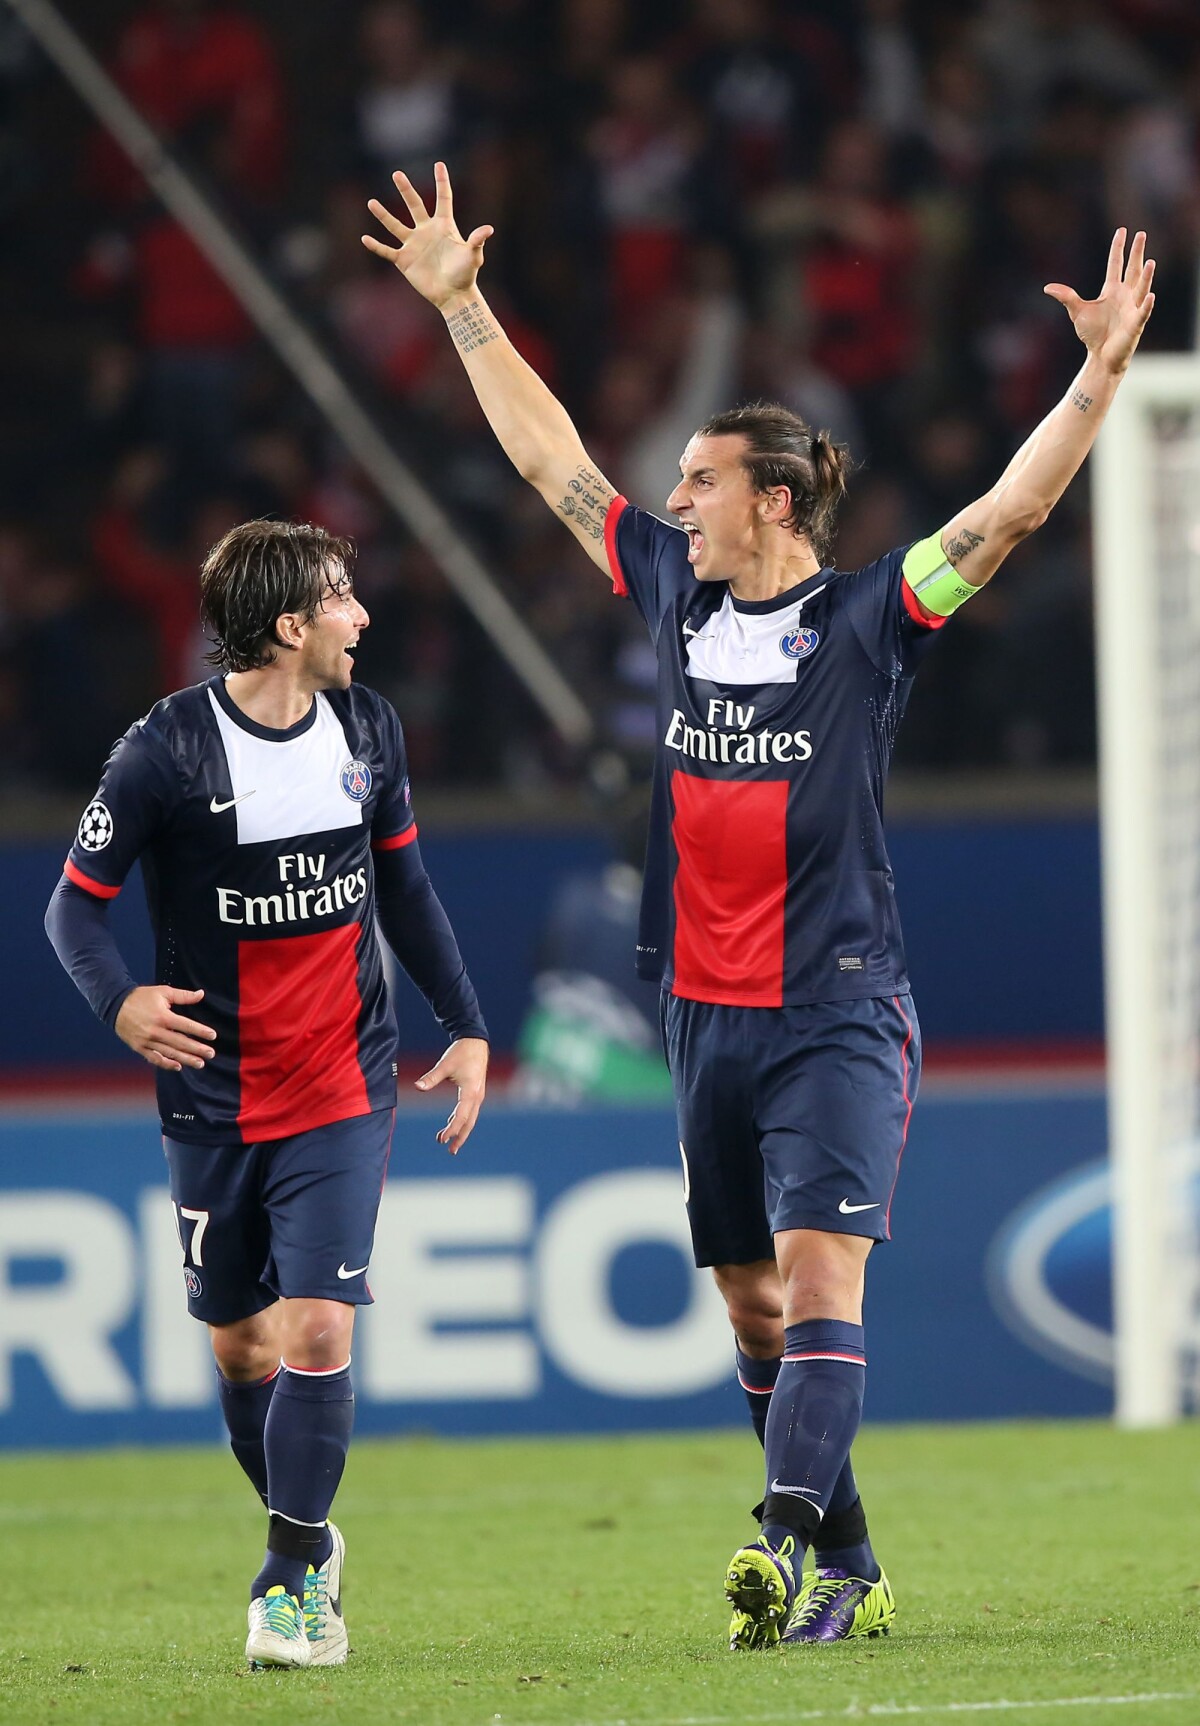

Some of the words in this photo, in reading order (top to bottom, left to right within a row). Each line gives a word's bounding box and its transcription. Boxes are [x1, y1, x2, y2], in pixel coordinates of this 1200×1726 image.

[707, 699, 755, 731] Fly
[664, 708, 813, 764] Emirates
[277, 853, 326, 882] Fly
[216, 867, 367, 926] Emirates
[172, 1112, 195, 1121] DRI-FIT
